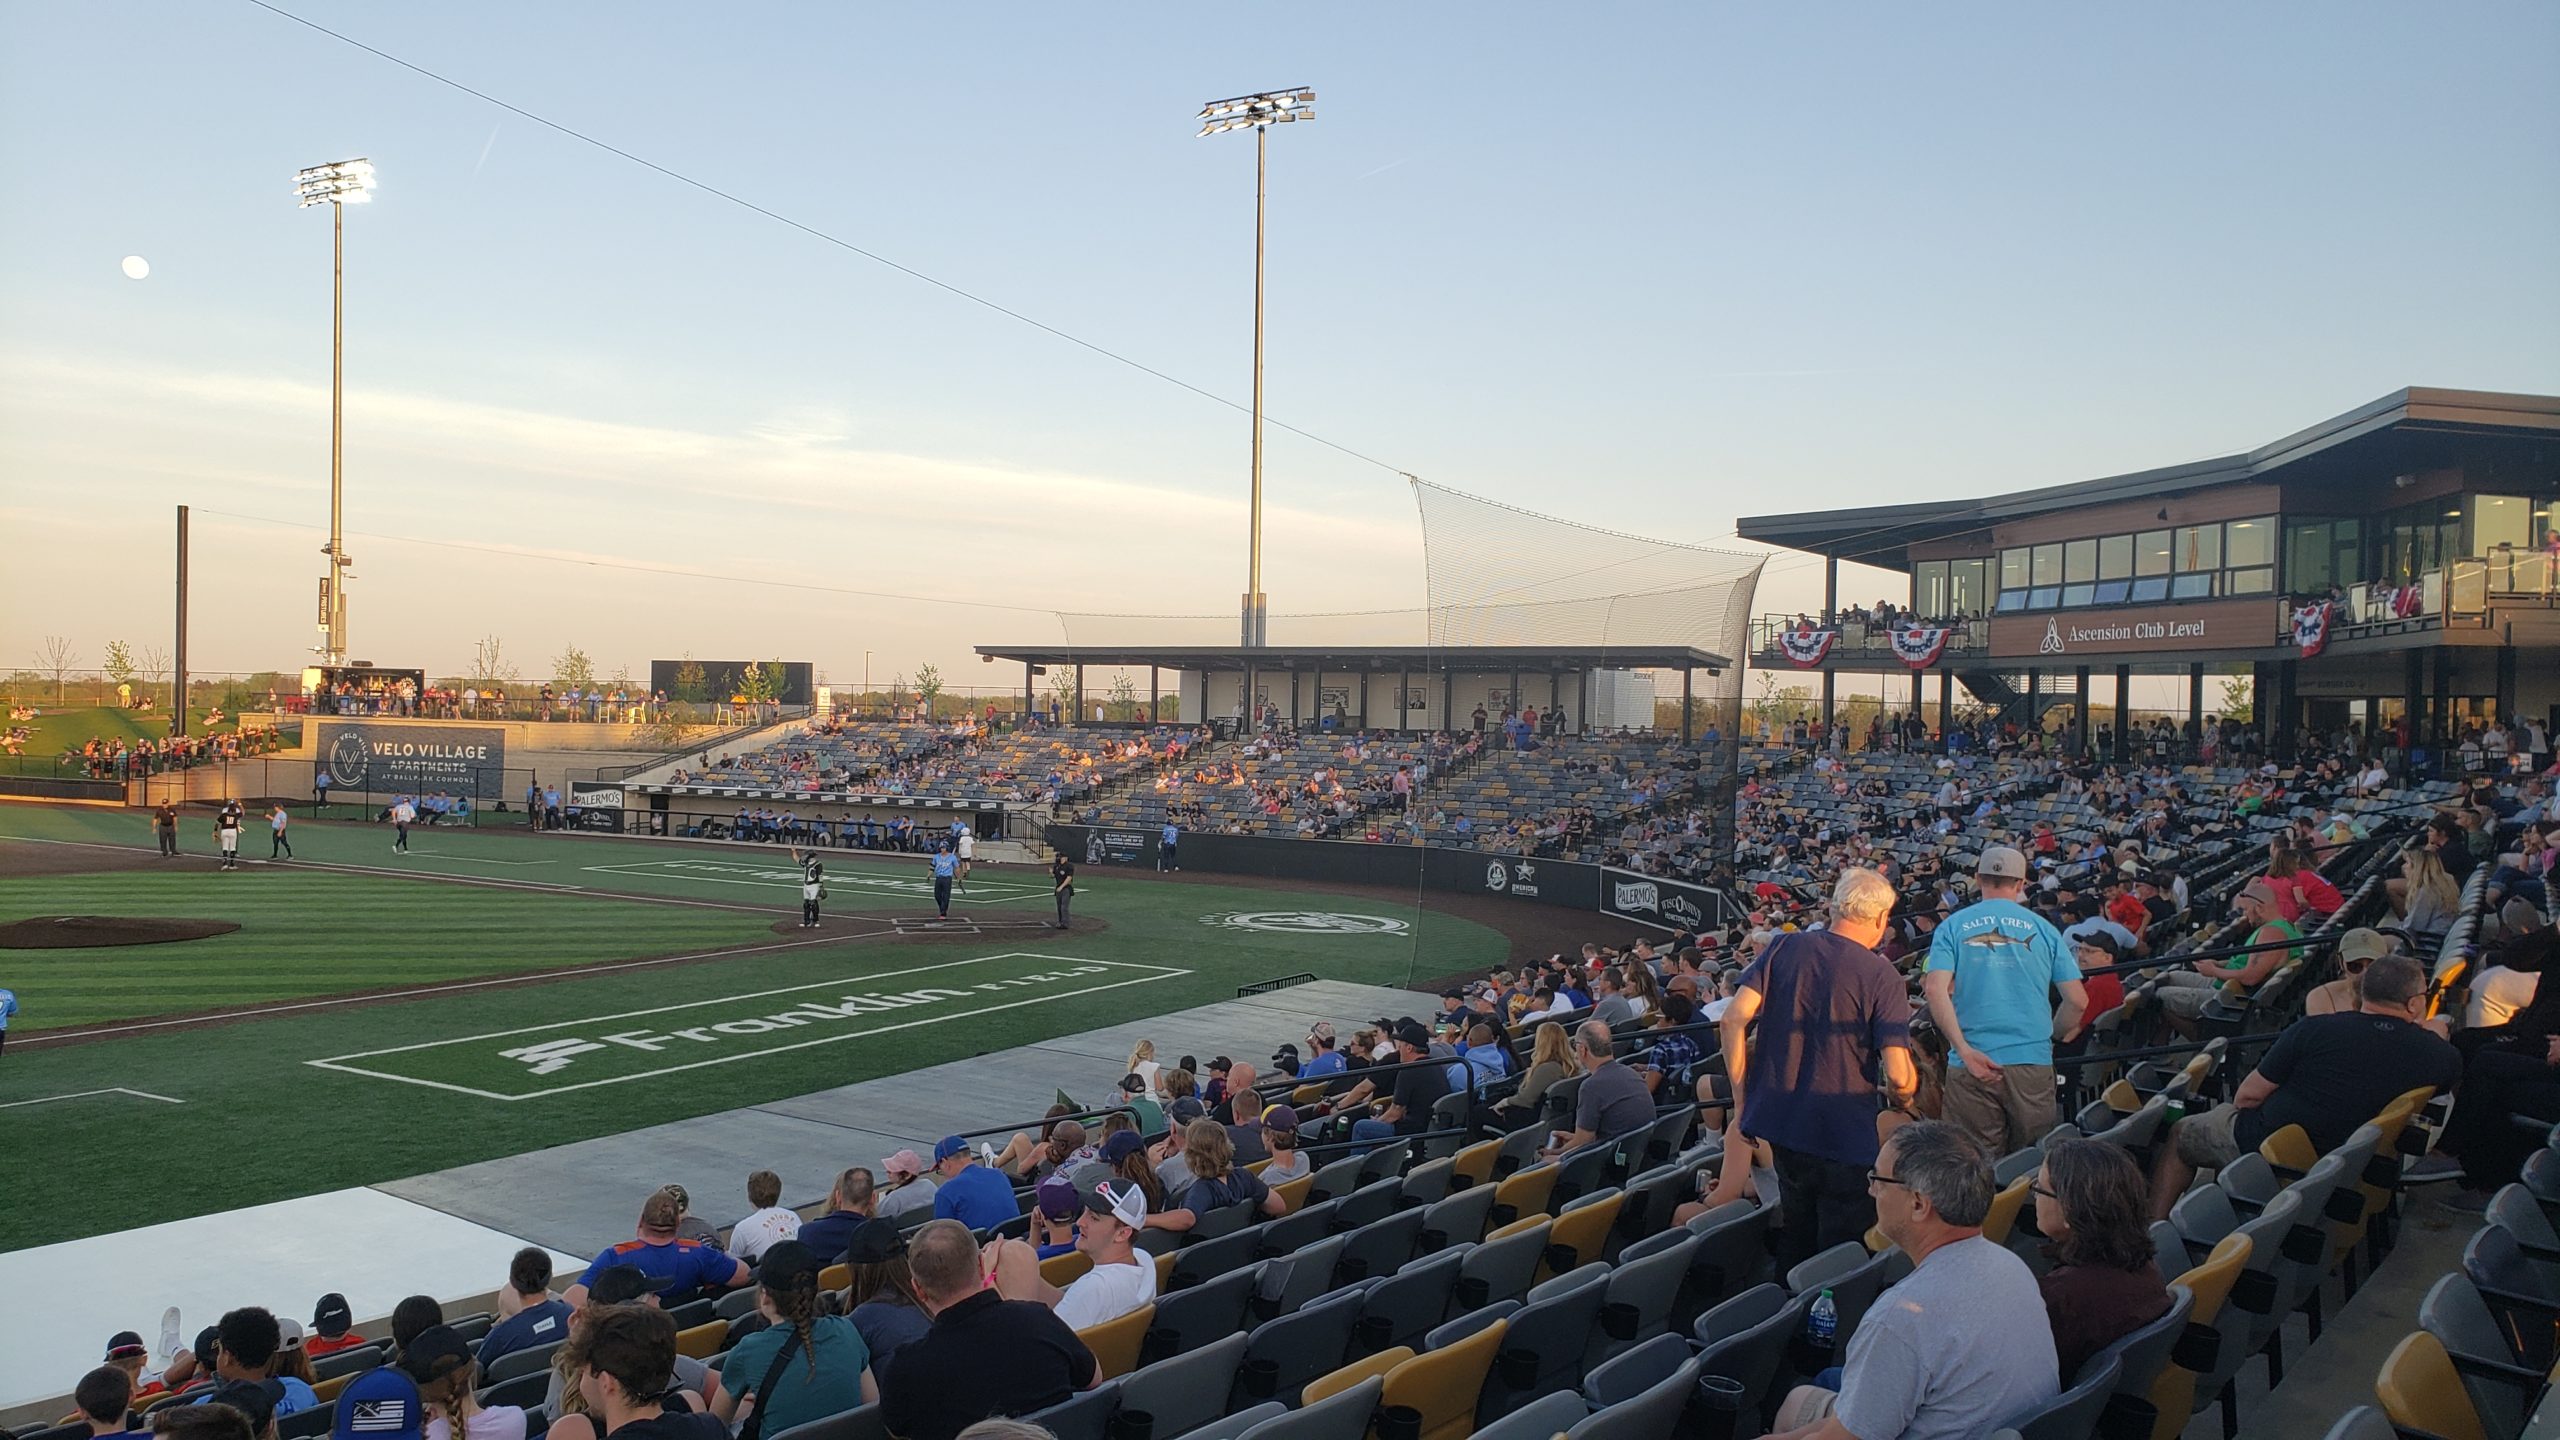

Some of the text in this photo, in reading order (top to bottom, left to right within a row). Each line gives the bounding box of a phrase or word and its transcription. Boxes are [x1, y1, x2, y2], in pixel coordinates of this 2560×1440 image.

[2068, 619, 2205, 642] Ascension Club Level
[373, 742, 487, 759] VELO VILLAGE
[390, 760, 467, 773] APARTMENTS
[436, 776, 475, 784] COMMONS
[575, 791, 620, 806] PALERMO'S
[1617, 886, 1656, 905] PALERMO'S
[1661, 895, 1702, 921] WISCONSIN'S
[1962, 915, 2033, 931] SALTY CREW
[600, 966, 1109, 1051] Franklin FIELD
